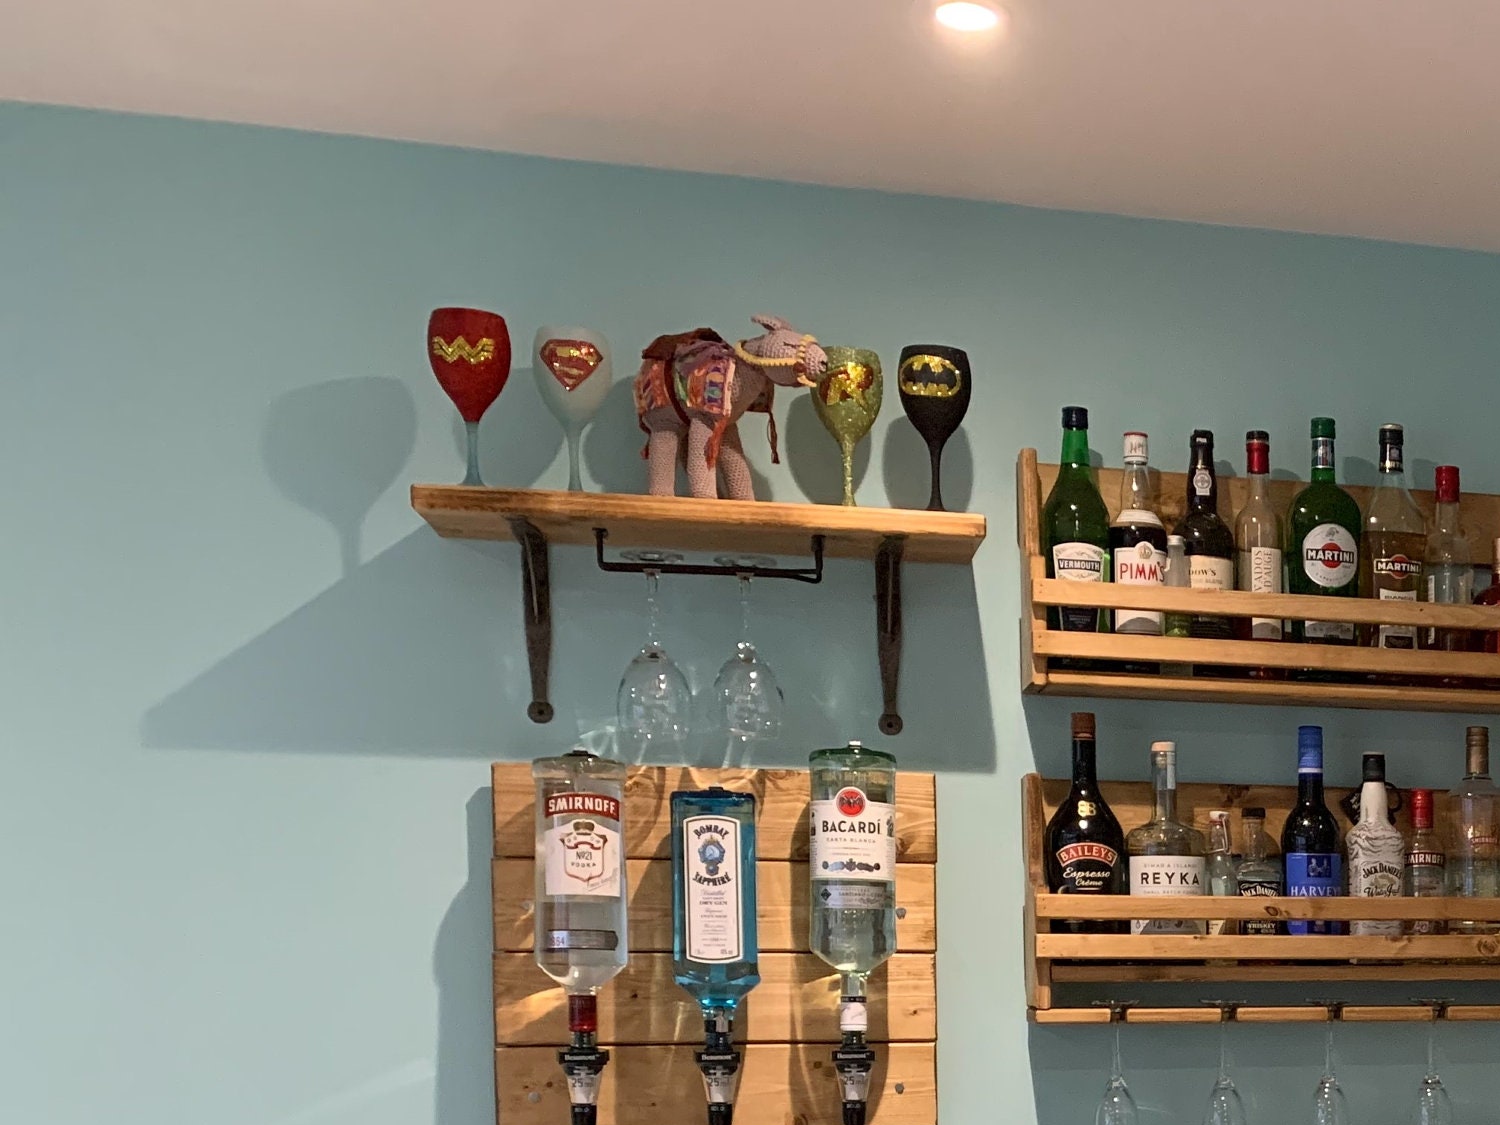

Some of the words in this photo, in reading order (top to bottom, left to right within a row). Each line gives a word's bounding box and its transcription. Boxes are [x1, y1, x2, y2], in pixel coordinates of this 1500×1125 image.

[1307, 550, 1354, 563] MARTINI
[1059, 558, 1100, 572] VERMOUTH
[1119, 562, 1165, 583] PIMM'S
[1254, 550, 1263, 593] VADOS
[1377, 561, 1419, 573] MARTINI
[548, 796, 617, 814] SMIRNOFF
[693, 824, 730, 840] BOMBAY
[821, 818, 881, 835] BACARDÍ
[1060, 846, 1113, 863] BAILEYS
[691, 871, 734, 887] SAPPHIRE
[1062, 867, 1111, 879] Espresso
[1140, 871, 1200, 886] REYKA
[1362, 864, 1379, 879] JACK
